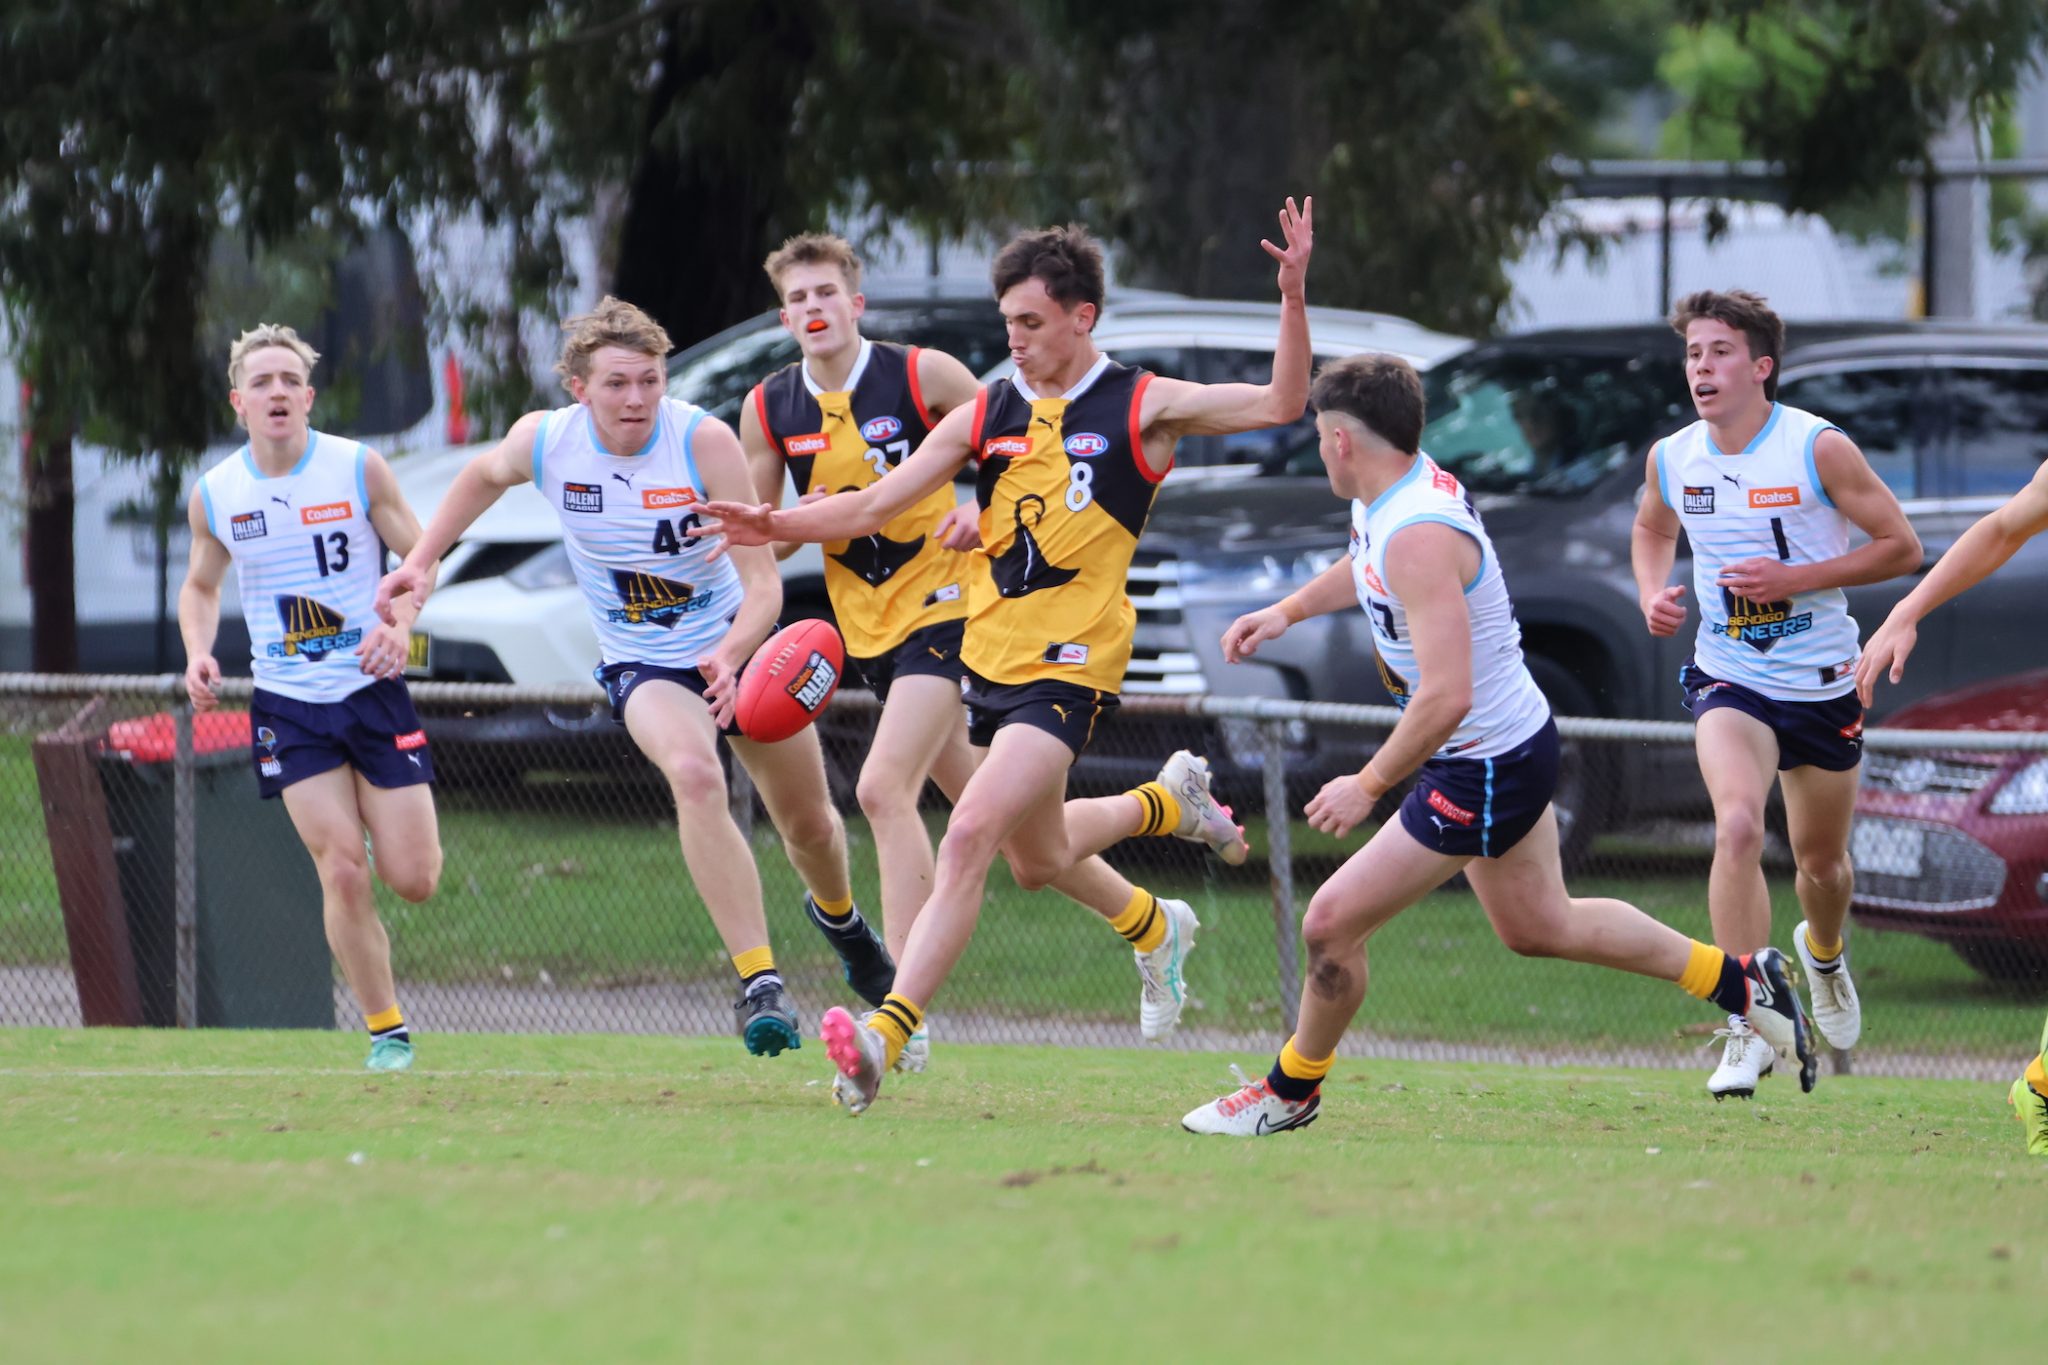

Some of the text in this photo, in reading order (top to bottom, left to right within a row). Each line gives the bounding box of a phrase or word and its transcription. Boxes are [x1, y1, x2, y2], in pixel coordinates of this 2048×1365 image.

[864, 419, 899, 438] AFL
[789, 438, 826, 452] Coates
[1067, 438, 1103, 451] AFL
[863, 439, 910, 488] 37
[1065, 461, 1093, 512] 8
[565, 491, 601, 506] TALENT
[648, 492, 691, 506] Coates
[1684, 494, 1713, 507] TALENT
[1753, 492, 1794, 505] Coates
[306, 506, 346, 521] Coates
[566, 503, 600, 512] LEAGUE
[1770, 517, 1790, 560] 1
[312, 531, 349, 577] 13
[1728, 611, 1784, 626] BENDIGO
[284, 626, 337, 642] BENDIGO
[267, 627, 362, 657] PIONEERS
[795, 658, 834, 707] TALENT
